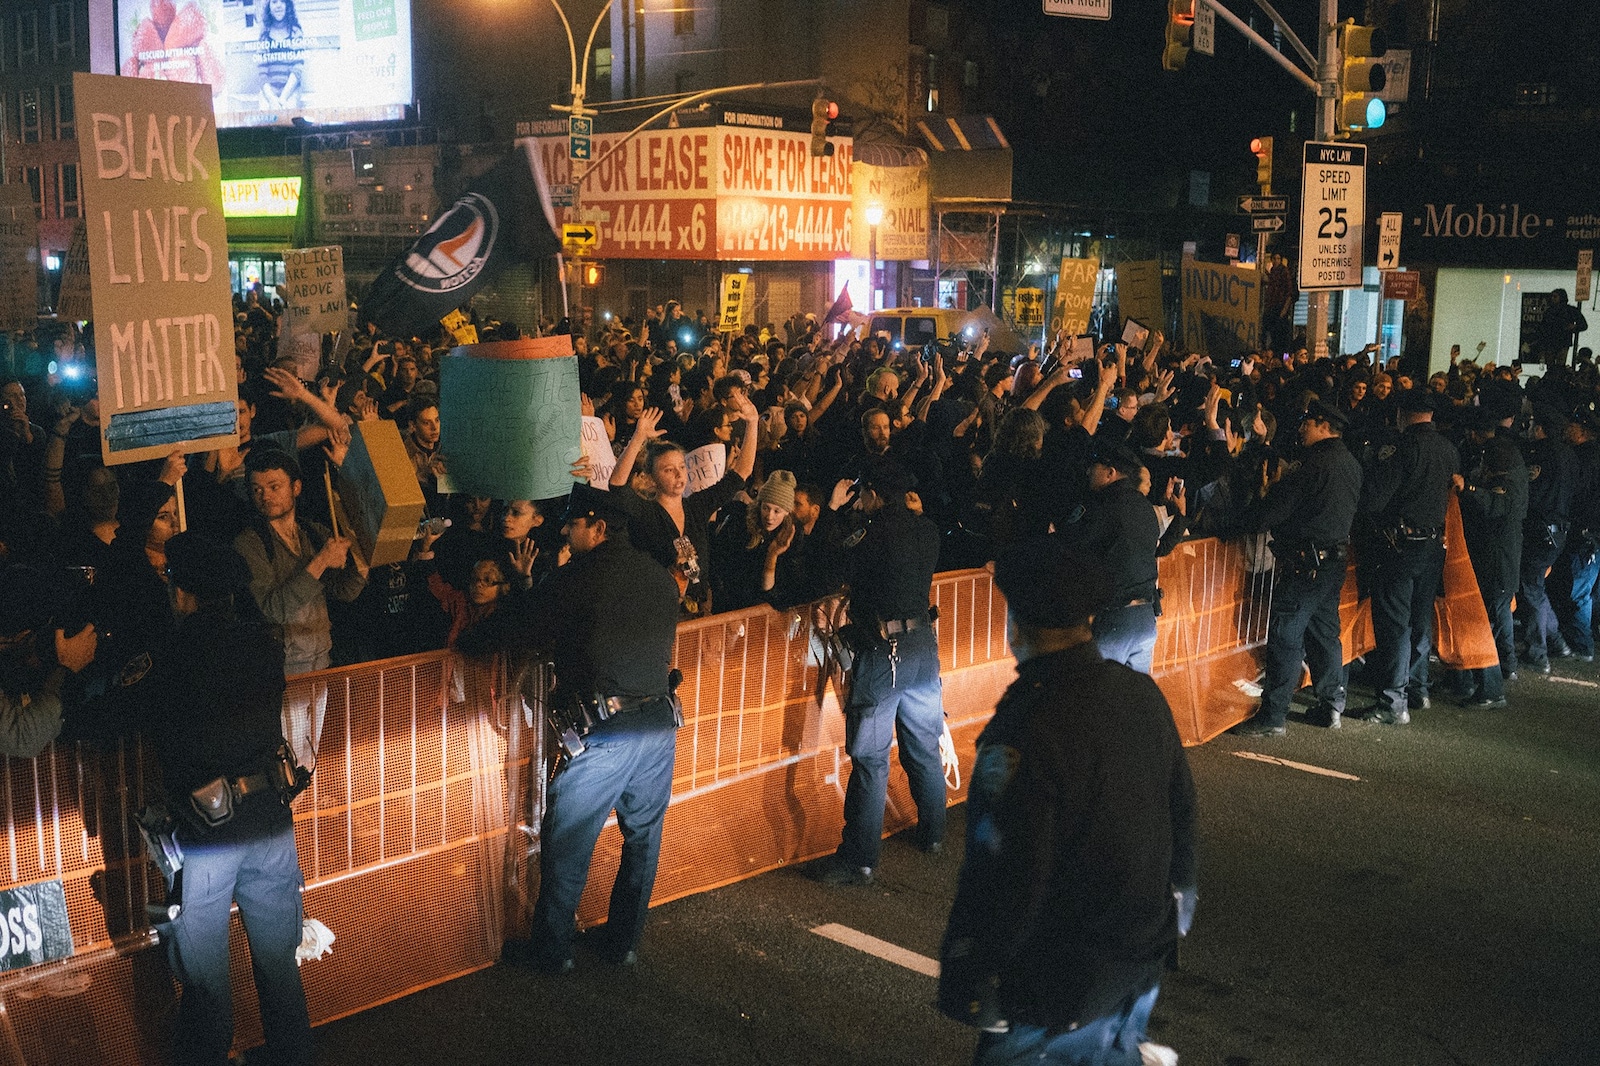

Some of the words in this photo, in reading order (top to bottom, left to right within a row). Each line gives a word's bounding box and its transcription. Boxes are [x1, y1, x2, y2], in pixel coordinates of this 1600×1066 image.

[531, 119, 569, 134] INFORMATI
[724, 112, 736, 123] FOR
[737, 113, 774, 127] INFORMATION
[775, 117, 783, 128] ON
[92, 112, 209, 184] BLACK
[1320, 149, 1336, 162] NYC
[1336, 150, 1351, 162] LAW
[586, 139, 629, 192] FOR
[636, 135, 708, 191] LEASE
[723, 133, 773, 191] SPACE
[778, 138, 807, 193] FOR
[811, 143, 853, 195] LEASE
[1319, 170, 1351, 184] SPEED
[269, 182, 301, 201] WOK
[1322, 188, 1348, 201] LIMIT
[1250, 200, 1262, 209] ONE
[1269, 200, 1284, 209] WAY
[898, 208, 925, 232] NAIL
[1317, 207, 1348, 239] 25
[1386, 218, 1397, 231] ALL
[1423, 203, 1540, 238] Mobile
[103, 206, 214, 284] LIVES
[1381, 235, 1399, 246] TRAFFIC
[284, 248, 338, 265] POLICE
[1319, 245, 1347, 254] UNLESS
[1312, 258, 1353, 268] OTHERWISE
[287, 268, 307, 281] ARE
[316, 264, 339, 277] NOT
[1063, 262, 1096, 282] FAR
[1318, 271, 1346, 281] POSTED
[293, 282, 333, 298] ABOVE
[1186, 268, 1255, 312] INDICT
[292, 305, 312, 317] THE
[320, 300, 344, 314] LAW!
[1055, 292, 1092, 309] FROM
[1051, 315, 1088, 335] OVER
[110, 313, 226, 409] MATTER
